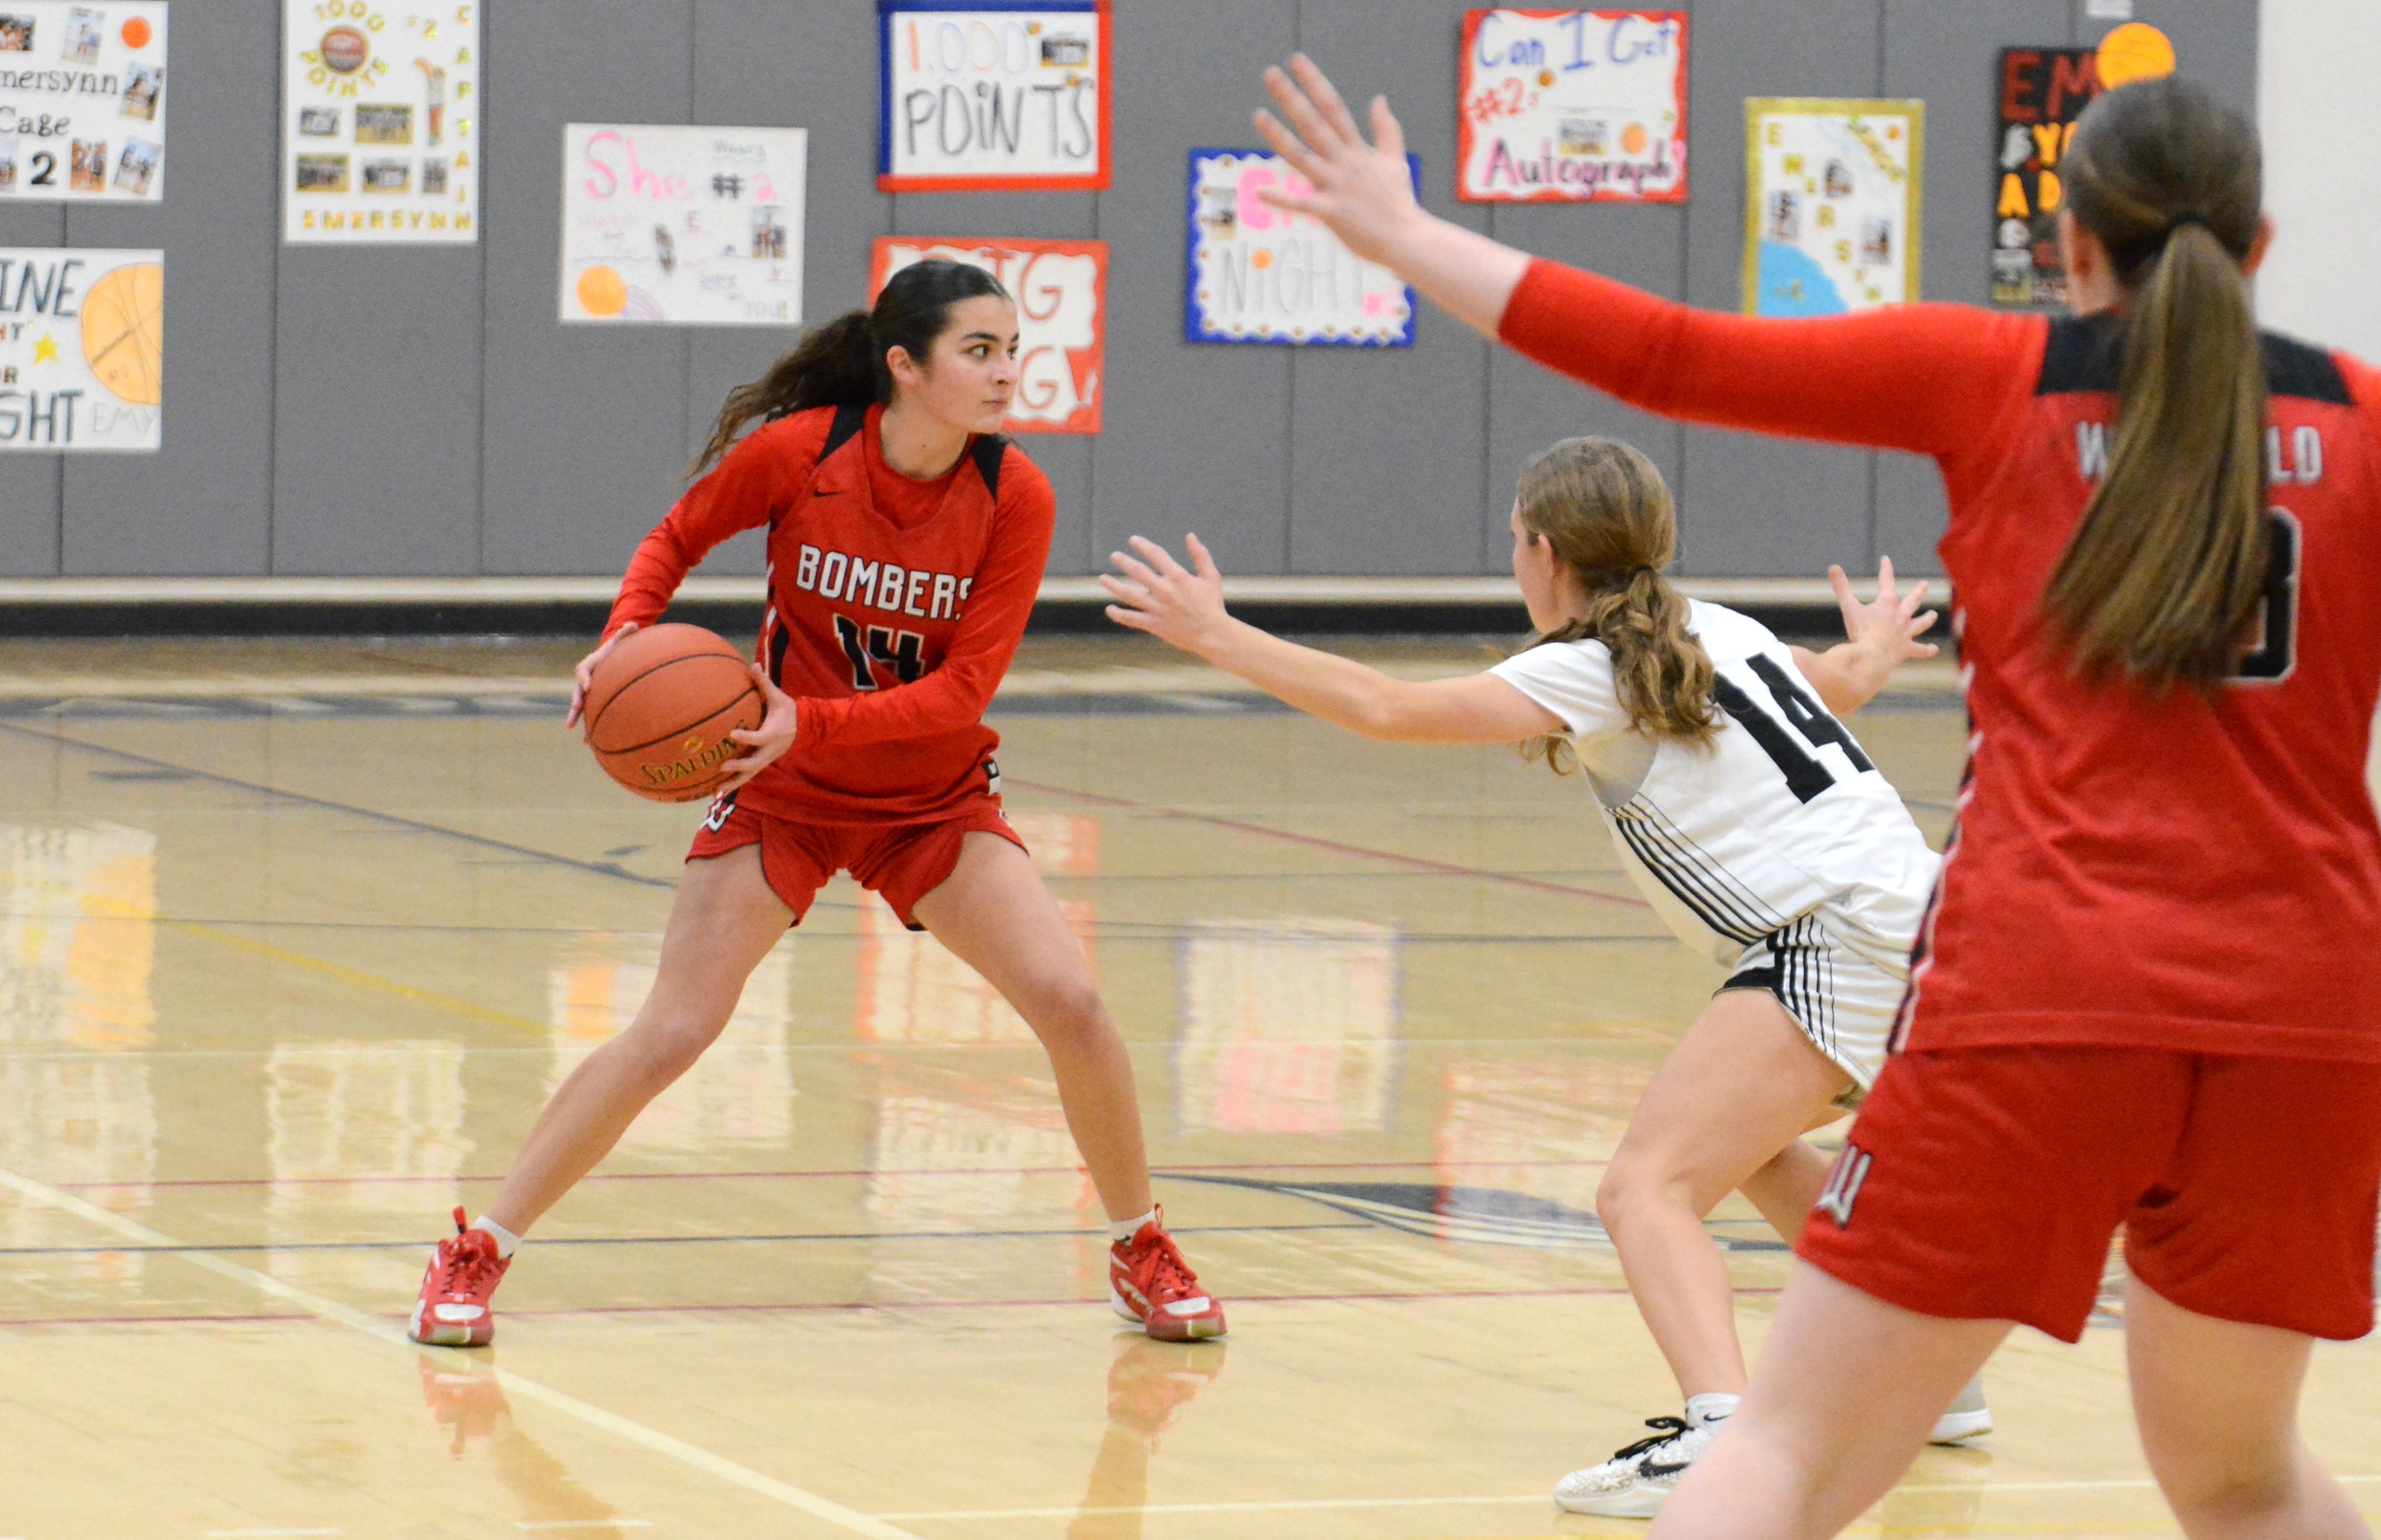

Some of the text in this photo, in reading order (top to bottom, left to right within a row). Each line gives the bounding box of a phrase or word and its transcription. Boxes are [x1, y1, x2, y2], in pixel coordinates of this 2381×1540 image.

[585, 130, 695, 201] She
[303, 209, 473, 230] EMERSYNN
[833, 612, 928, 692] 14
[640, 717, 751, 785] SPALDIN
